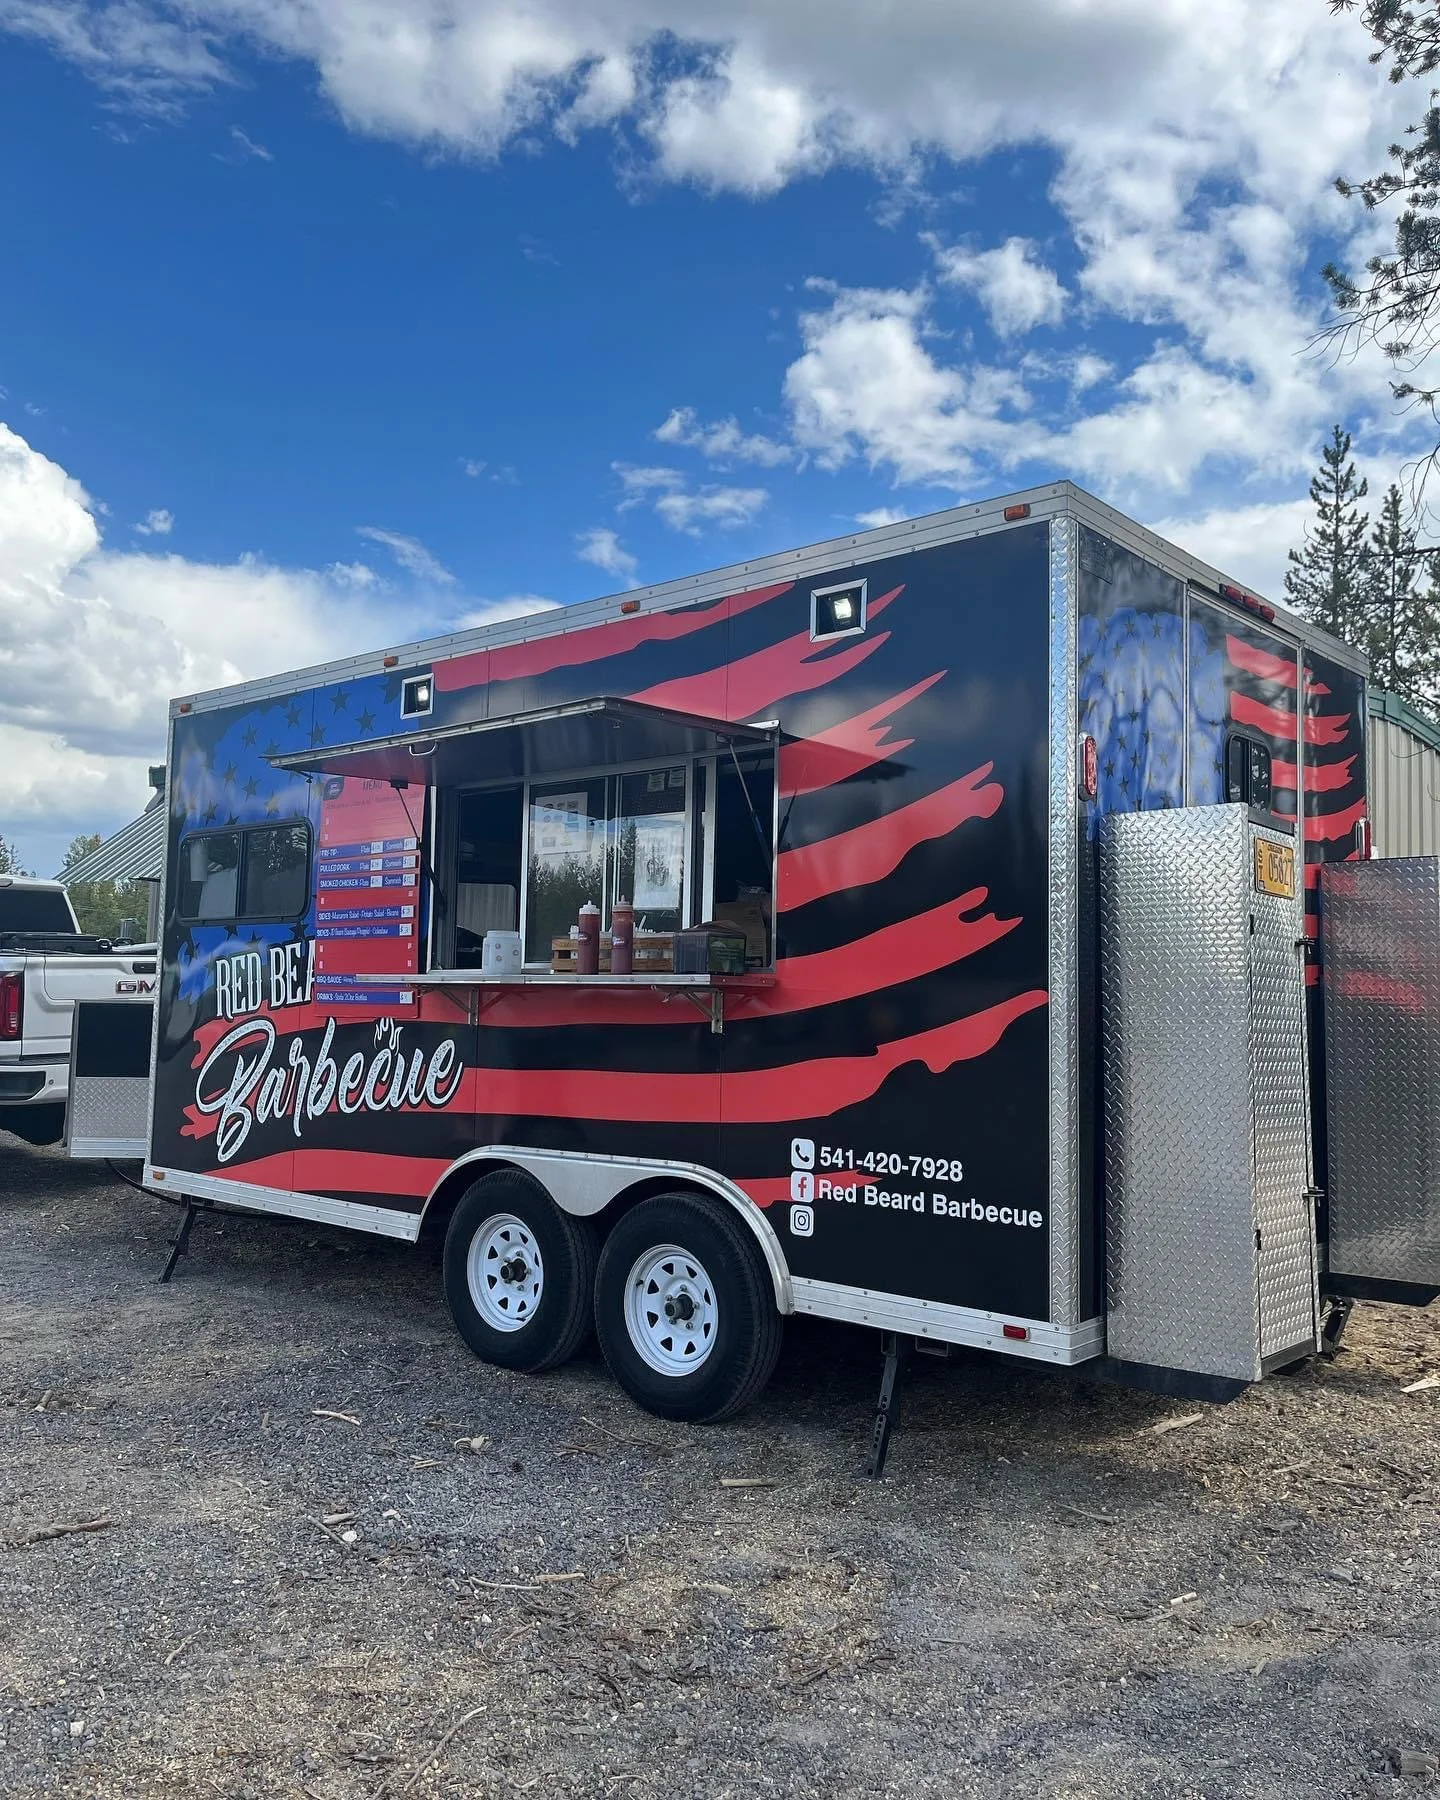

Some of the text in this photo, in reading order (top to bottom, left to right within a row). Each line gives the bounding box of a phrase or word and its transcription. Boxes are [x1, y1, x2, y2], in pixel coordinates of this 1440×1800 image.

[216, 951, 262, 1019] RED
[196, 1016, 463, 1163] Barbecue
[820, 1146, 963, 1182] 541-420-7928
[818, 1179, 1043, 1229] Red Beard Barbecue
